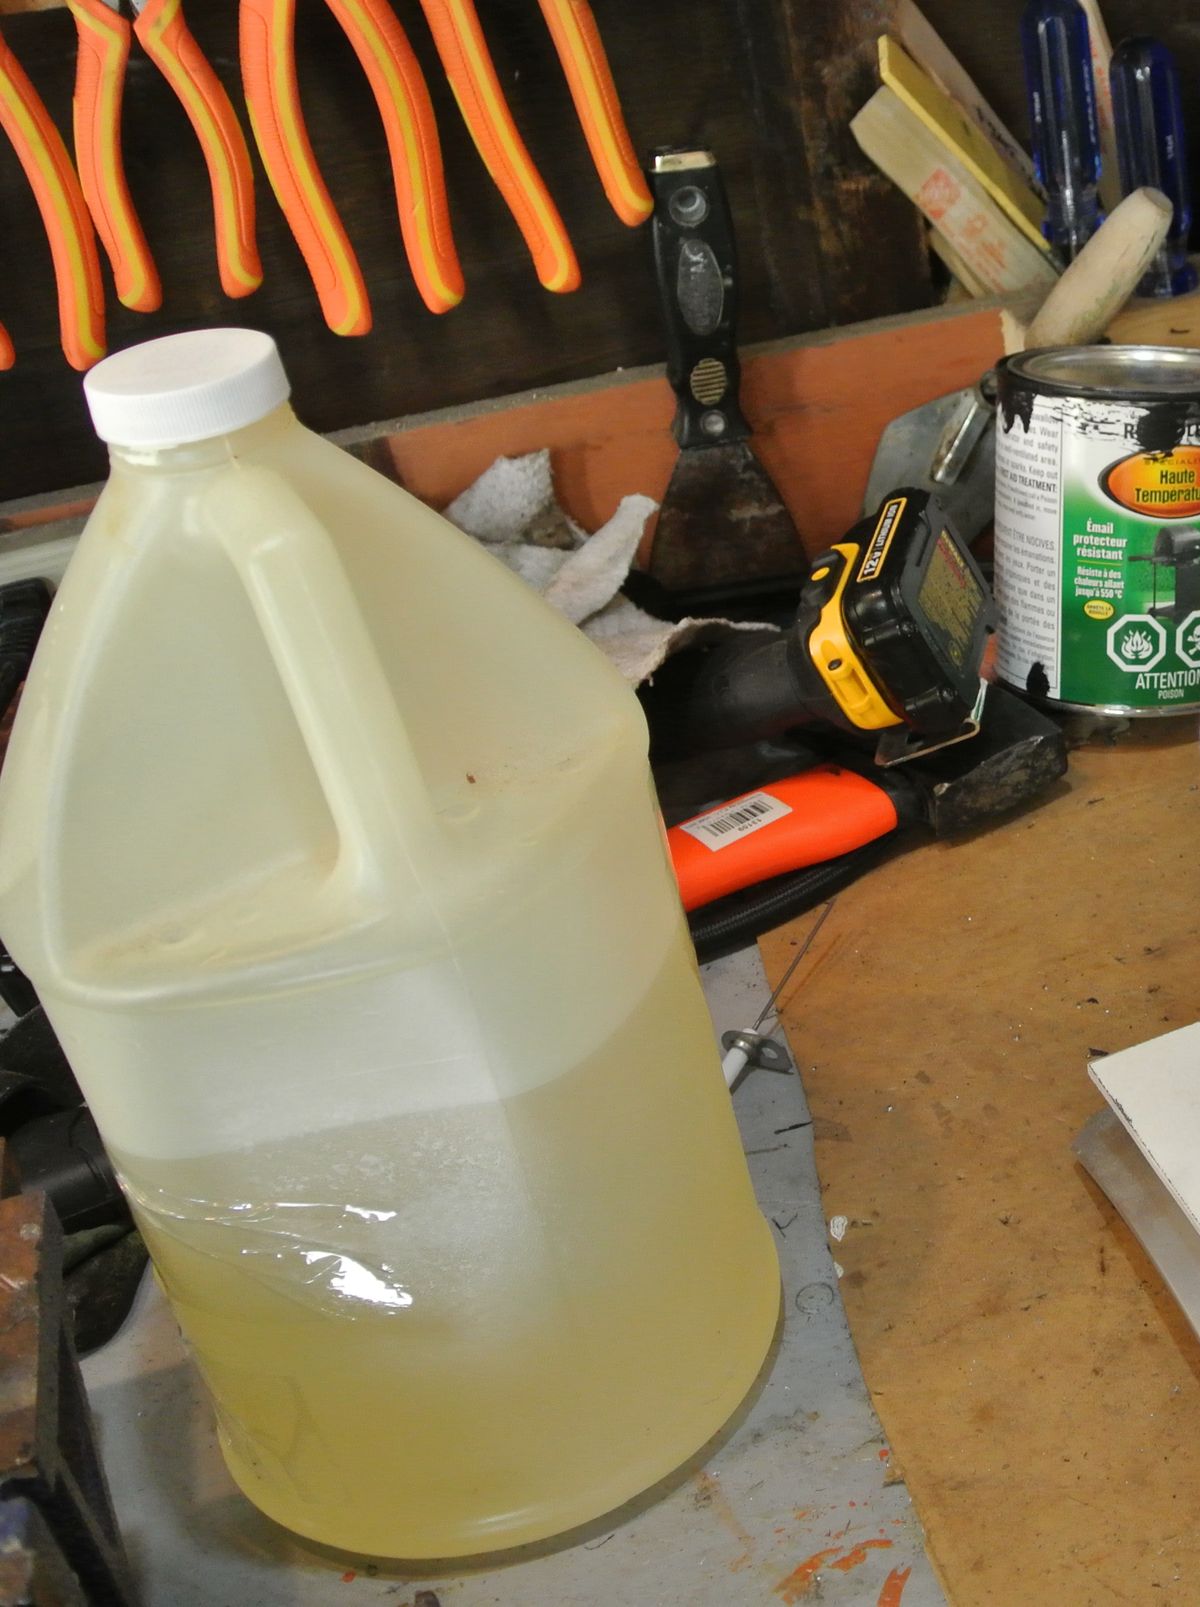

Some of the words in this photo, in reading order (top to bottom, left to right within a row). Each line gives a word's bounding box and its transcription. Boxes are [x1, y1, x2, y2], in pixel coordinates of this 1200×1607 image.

[1160, 468, 1195, 484] Haute
[1086, 517, 1114, 534] Émail
[1073, 534, 1128, 548] protecteur
[1077, 545, 1123, 560] résistant
[1158, 689, 1184, 700] POISON
